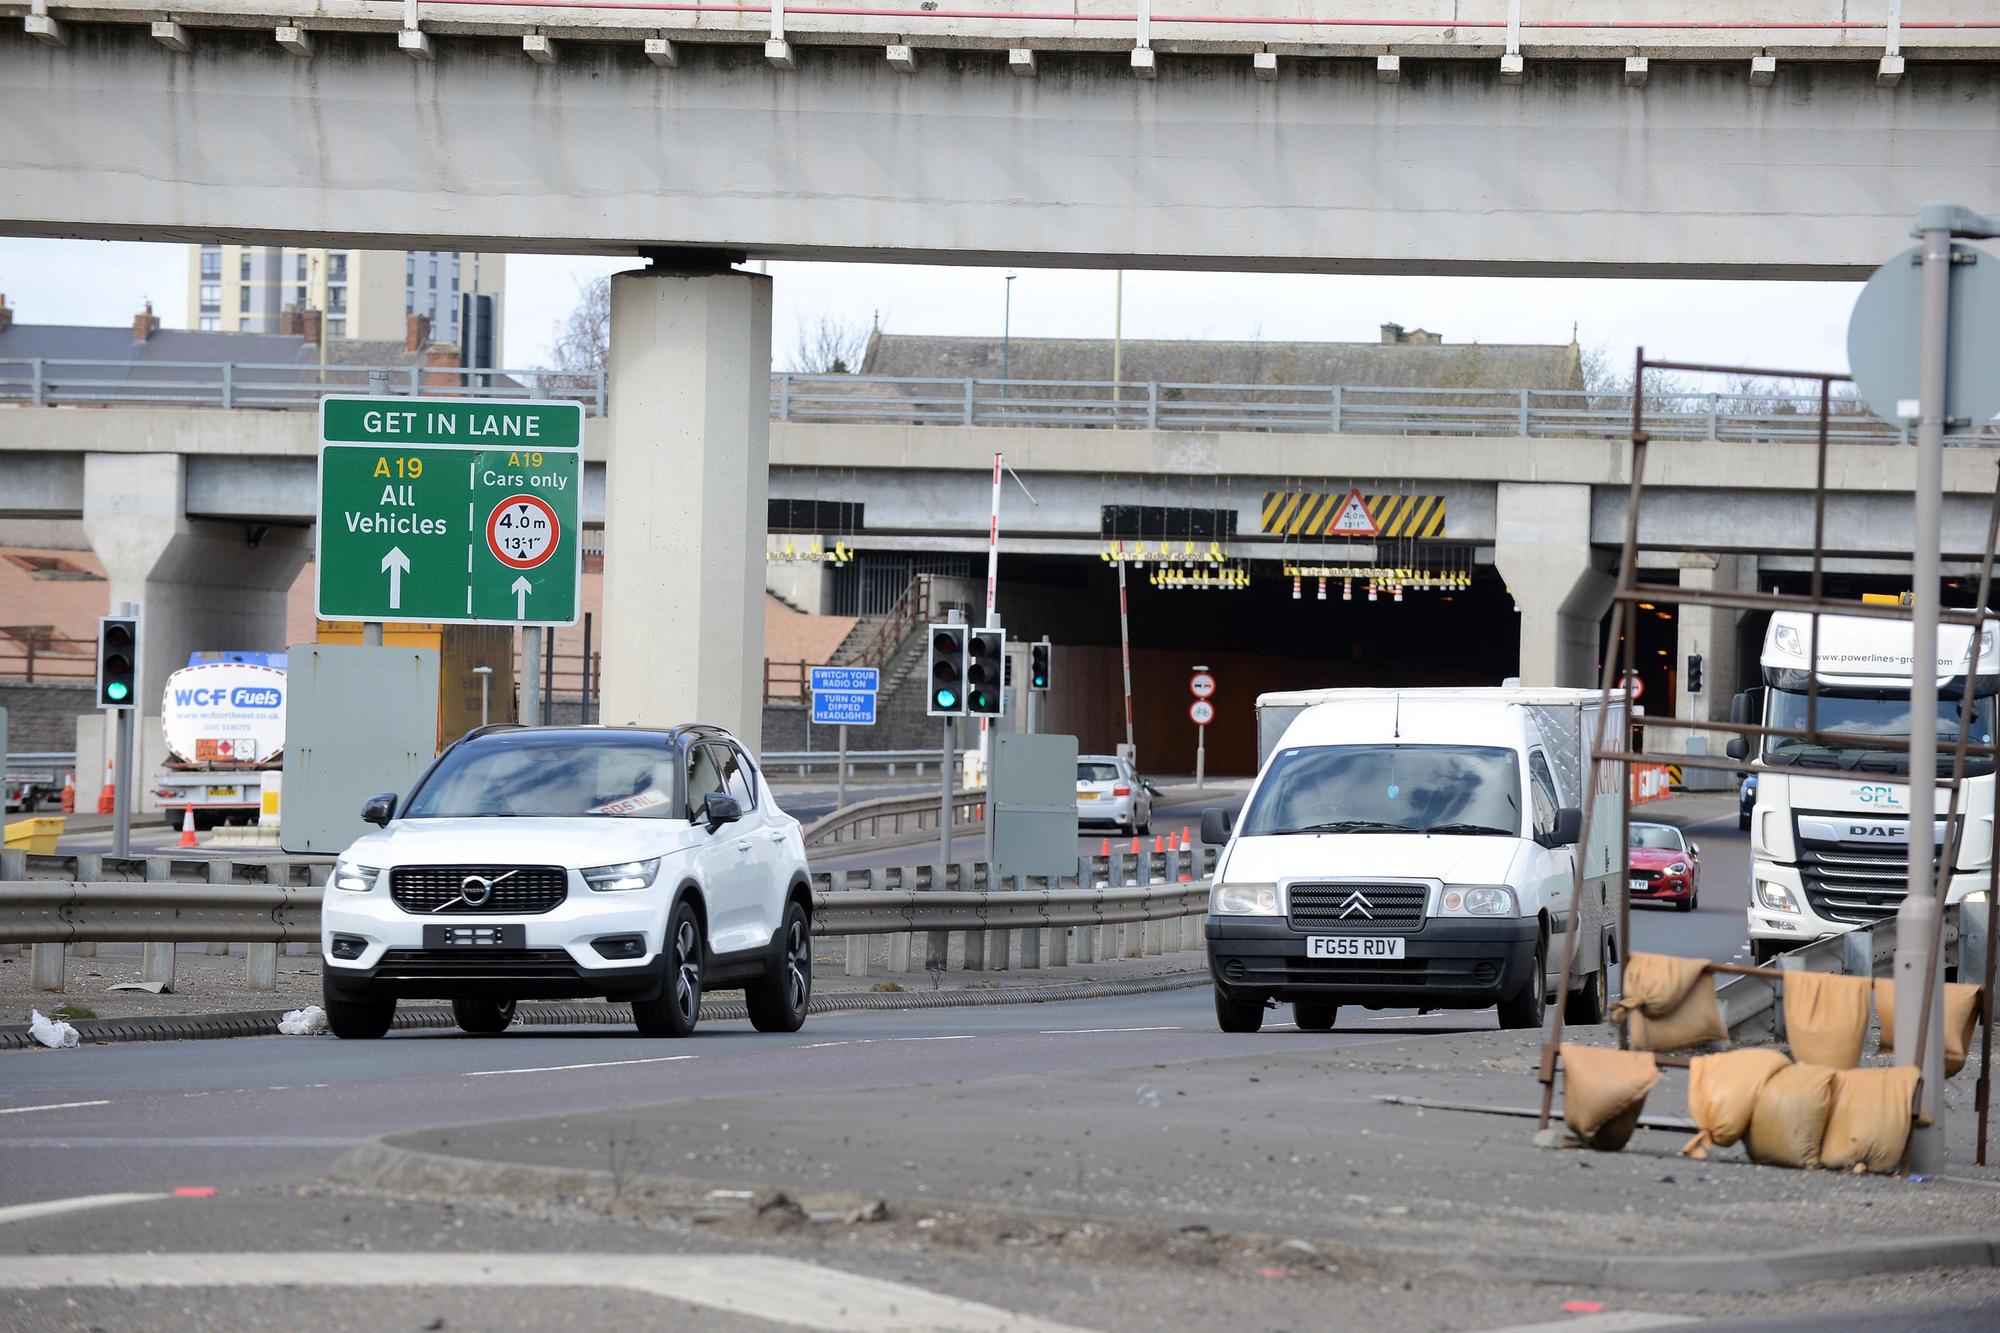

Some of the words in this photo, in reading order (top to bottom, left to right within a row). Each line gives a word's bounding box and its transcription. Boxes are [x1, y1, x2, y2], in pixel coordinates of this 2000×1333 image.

[363, 411, 417, 434] GET
[427, 413, 456, 435] IN
[469, 414, 540, 437] LANE
[373, 456, 423, 479] A19
[507, 451, 543, 468] A19
[483, 470, 524, 487] Cars
[530, 472, 568, 491] only
[380, 484, 415, 507] All
[344, 511, 447, 535] Vehicles
[815, 671, 848, 679] SWITCH
[850, 671, 875, 680] YOUR
[852, 680, 866, 688] ON
[234, 690, 278, 705] Fuels
[824, 695, 848, 703] TURN
[850, 695, 865, 703] ON
[828, 703, 860, 711] DIPPED
[816, 712, 871, 720] HEADLIGHTS
[1859, 785, 1899, 804] SPL
[1849, 825, 1905, 837] DAF
[1314, 939, 1358, 955] FG55
[1364, 939, 1397, 955] RDV
